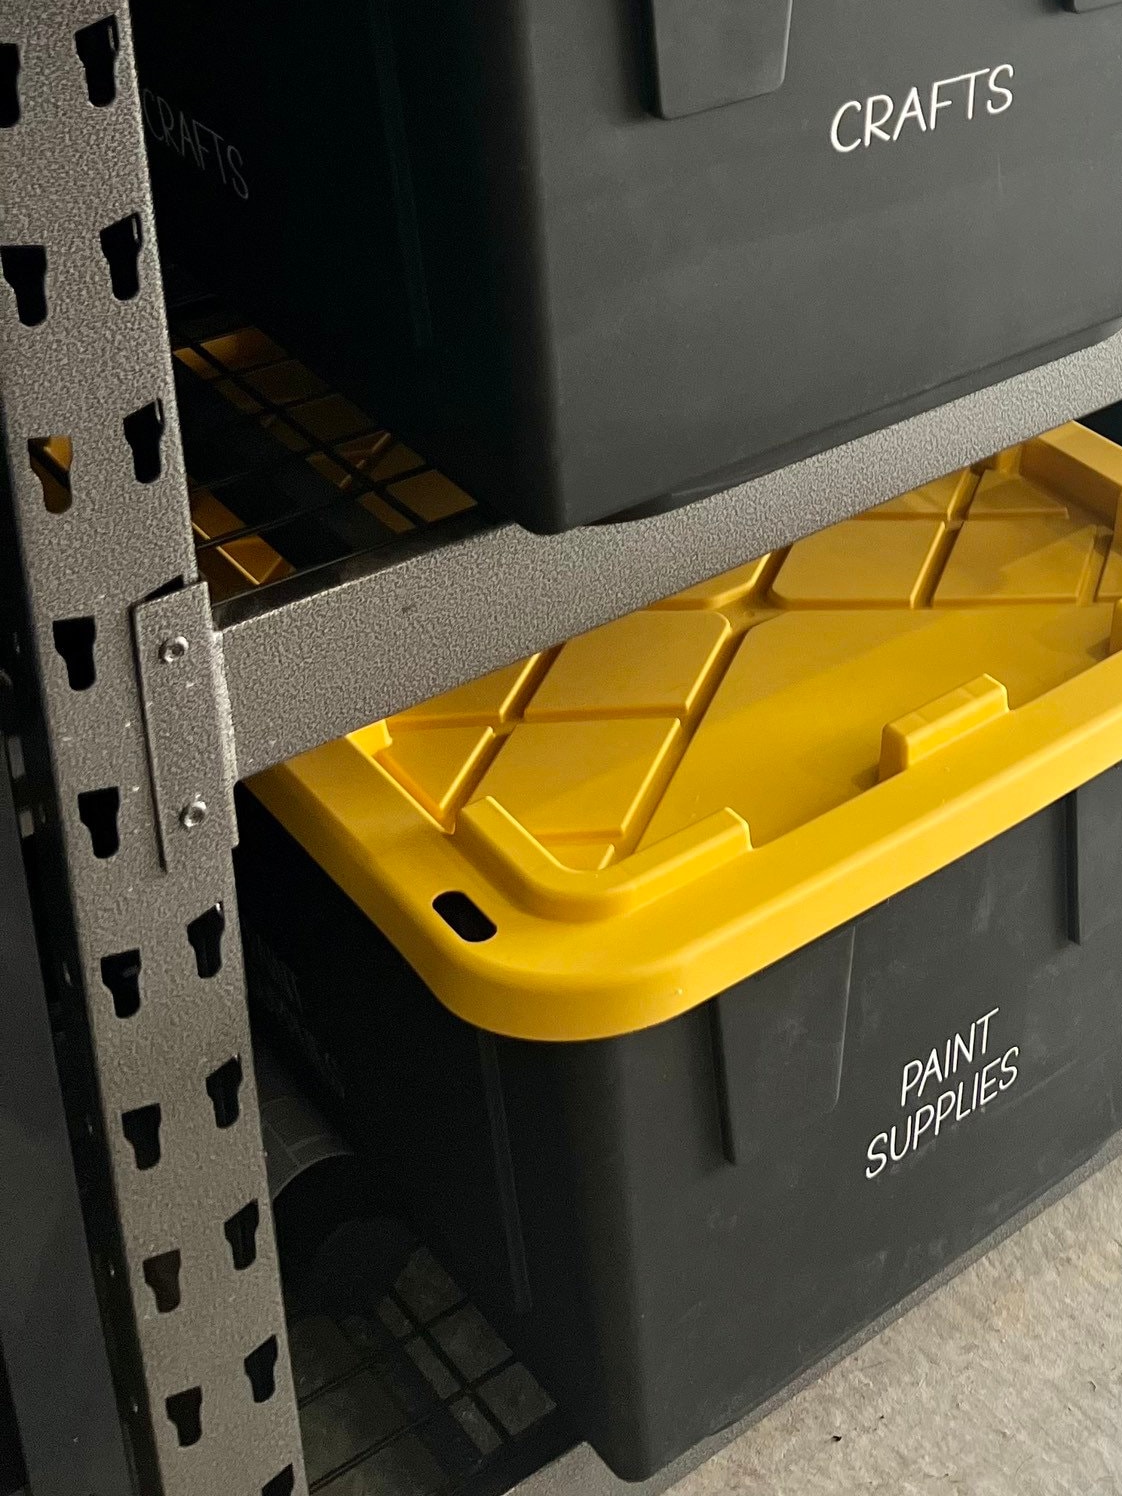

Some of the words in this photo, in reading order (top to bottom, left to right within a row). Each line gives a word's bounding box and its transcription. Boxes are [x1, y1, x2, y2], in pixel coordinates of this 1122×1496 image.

[142, 87, 250, 201] CRAFTS
[829, 63, 1014, 153] CRAFTS
[900, 1007, 1000, 1108] PAINT
[865, 1046, 1019, 1180] SUPPLIES
